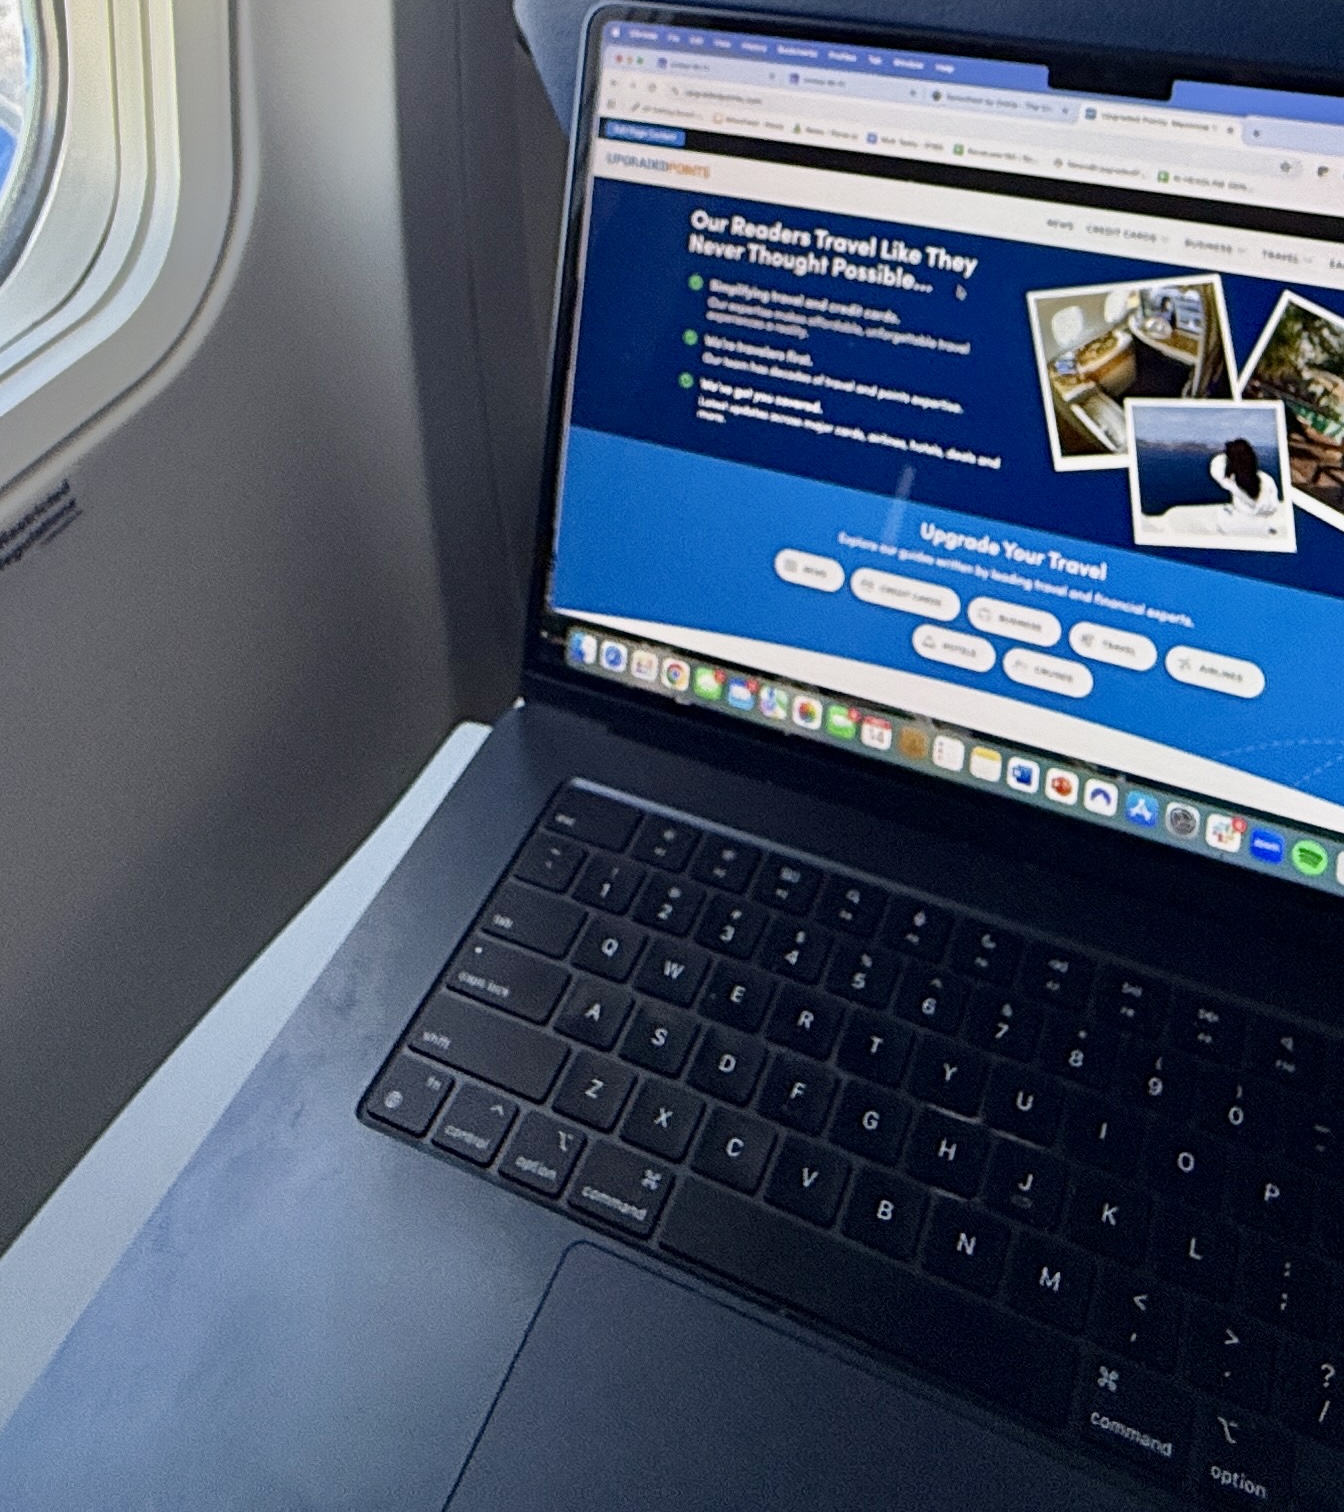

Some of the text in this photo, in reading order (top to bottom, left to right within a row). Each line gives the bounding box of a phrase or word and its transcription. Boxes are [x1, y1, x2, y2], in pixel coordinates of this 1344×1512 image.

[690, 209, 979, 280] Our Readers Travel Like They
[688, 233, 934, 294] Never Thought Possible...
[919, 520, 1108, 583] Upgrade Your Travel
[878, 540, 897, 555] our
[897, 544, 936, 566] guides
[936, 554, 974, 576] written
[974, 565, 989, 582] by
[988, 568, 1035, 593] leading
[1034, 578, 1068, 600] travel
[1067, 585, 1094, 605] and
[1093, 590, 1146, 616] financial
[1145, 604, 1196, 630] experts.
[601, 883, 611, 898] 1
[493, 912, 513, 928] tab
[658, 904, 673, 920] 2
[720, 925, 735, 942] 3
[602, 938, 619, 956] Q
[784, 949, 800, 966] 4
[663, 961, 685, 979] W
[851, 972, 866, 989] 5
[730, 986, 747, 1004] E
[584, 1003, 602, 1021] A
[921, 997, 936, 1015] 6
[798, 1010, 814, 1029] R
[422, 1029, 451, 1050] shift
[651, 1028, 668, 1047] S
[995, 1022, 1009, 1039] 7
[869, 1035, 883, 1054] T
[718, 1054, 736, 1073] D
[1068, 1049, 1084, 1067] 8
[943, 1063, 958, 1081] Y
[427, 1076, 441, 1091] fn
[585, 1078, 604, 1099] Z
[790, 1081, 807, 1099] F
[1148, 1077, 1163, 1095] 9
[1016, 1091, 1033, 1111] U
[654, 1107, 674, 1128] X
[862, 1110, 880, 1131] G
[1228, 1106, 1244, 1126] 0
[444, 1124, 490, 1150] control
[1099, 1122, 1108, 1140] I
[726, 1137, 744, 1157] C
[938, 1138, 957, 1161] H
[514, 1155, 557, 1180] option
[1177, 1151, 1195, 1172] O
[801, 1168, 818, 1187] V
[1018, 1174, 1034, 1192] J
[1264, 1183, 1280, 1202] P
[581, 1186, 648, 1221] command
[877, 1200, 894, 1221] B
[1101, 1203, 1120, 1226] K
[957, 1232, 977, 1256] N
[1189, 1237, 1203, 1260] L
[1039, 1266, 1062, 1292] M
[1090, 1409, 1173, 1458] command
[1210, 1463, 1267, 1500] option
